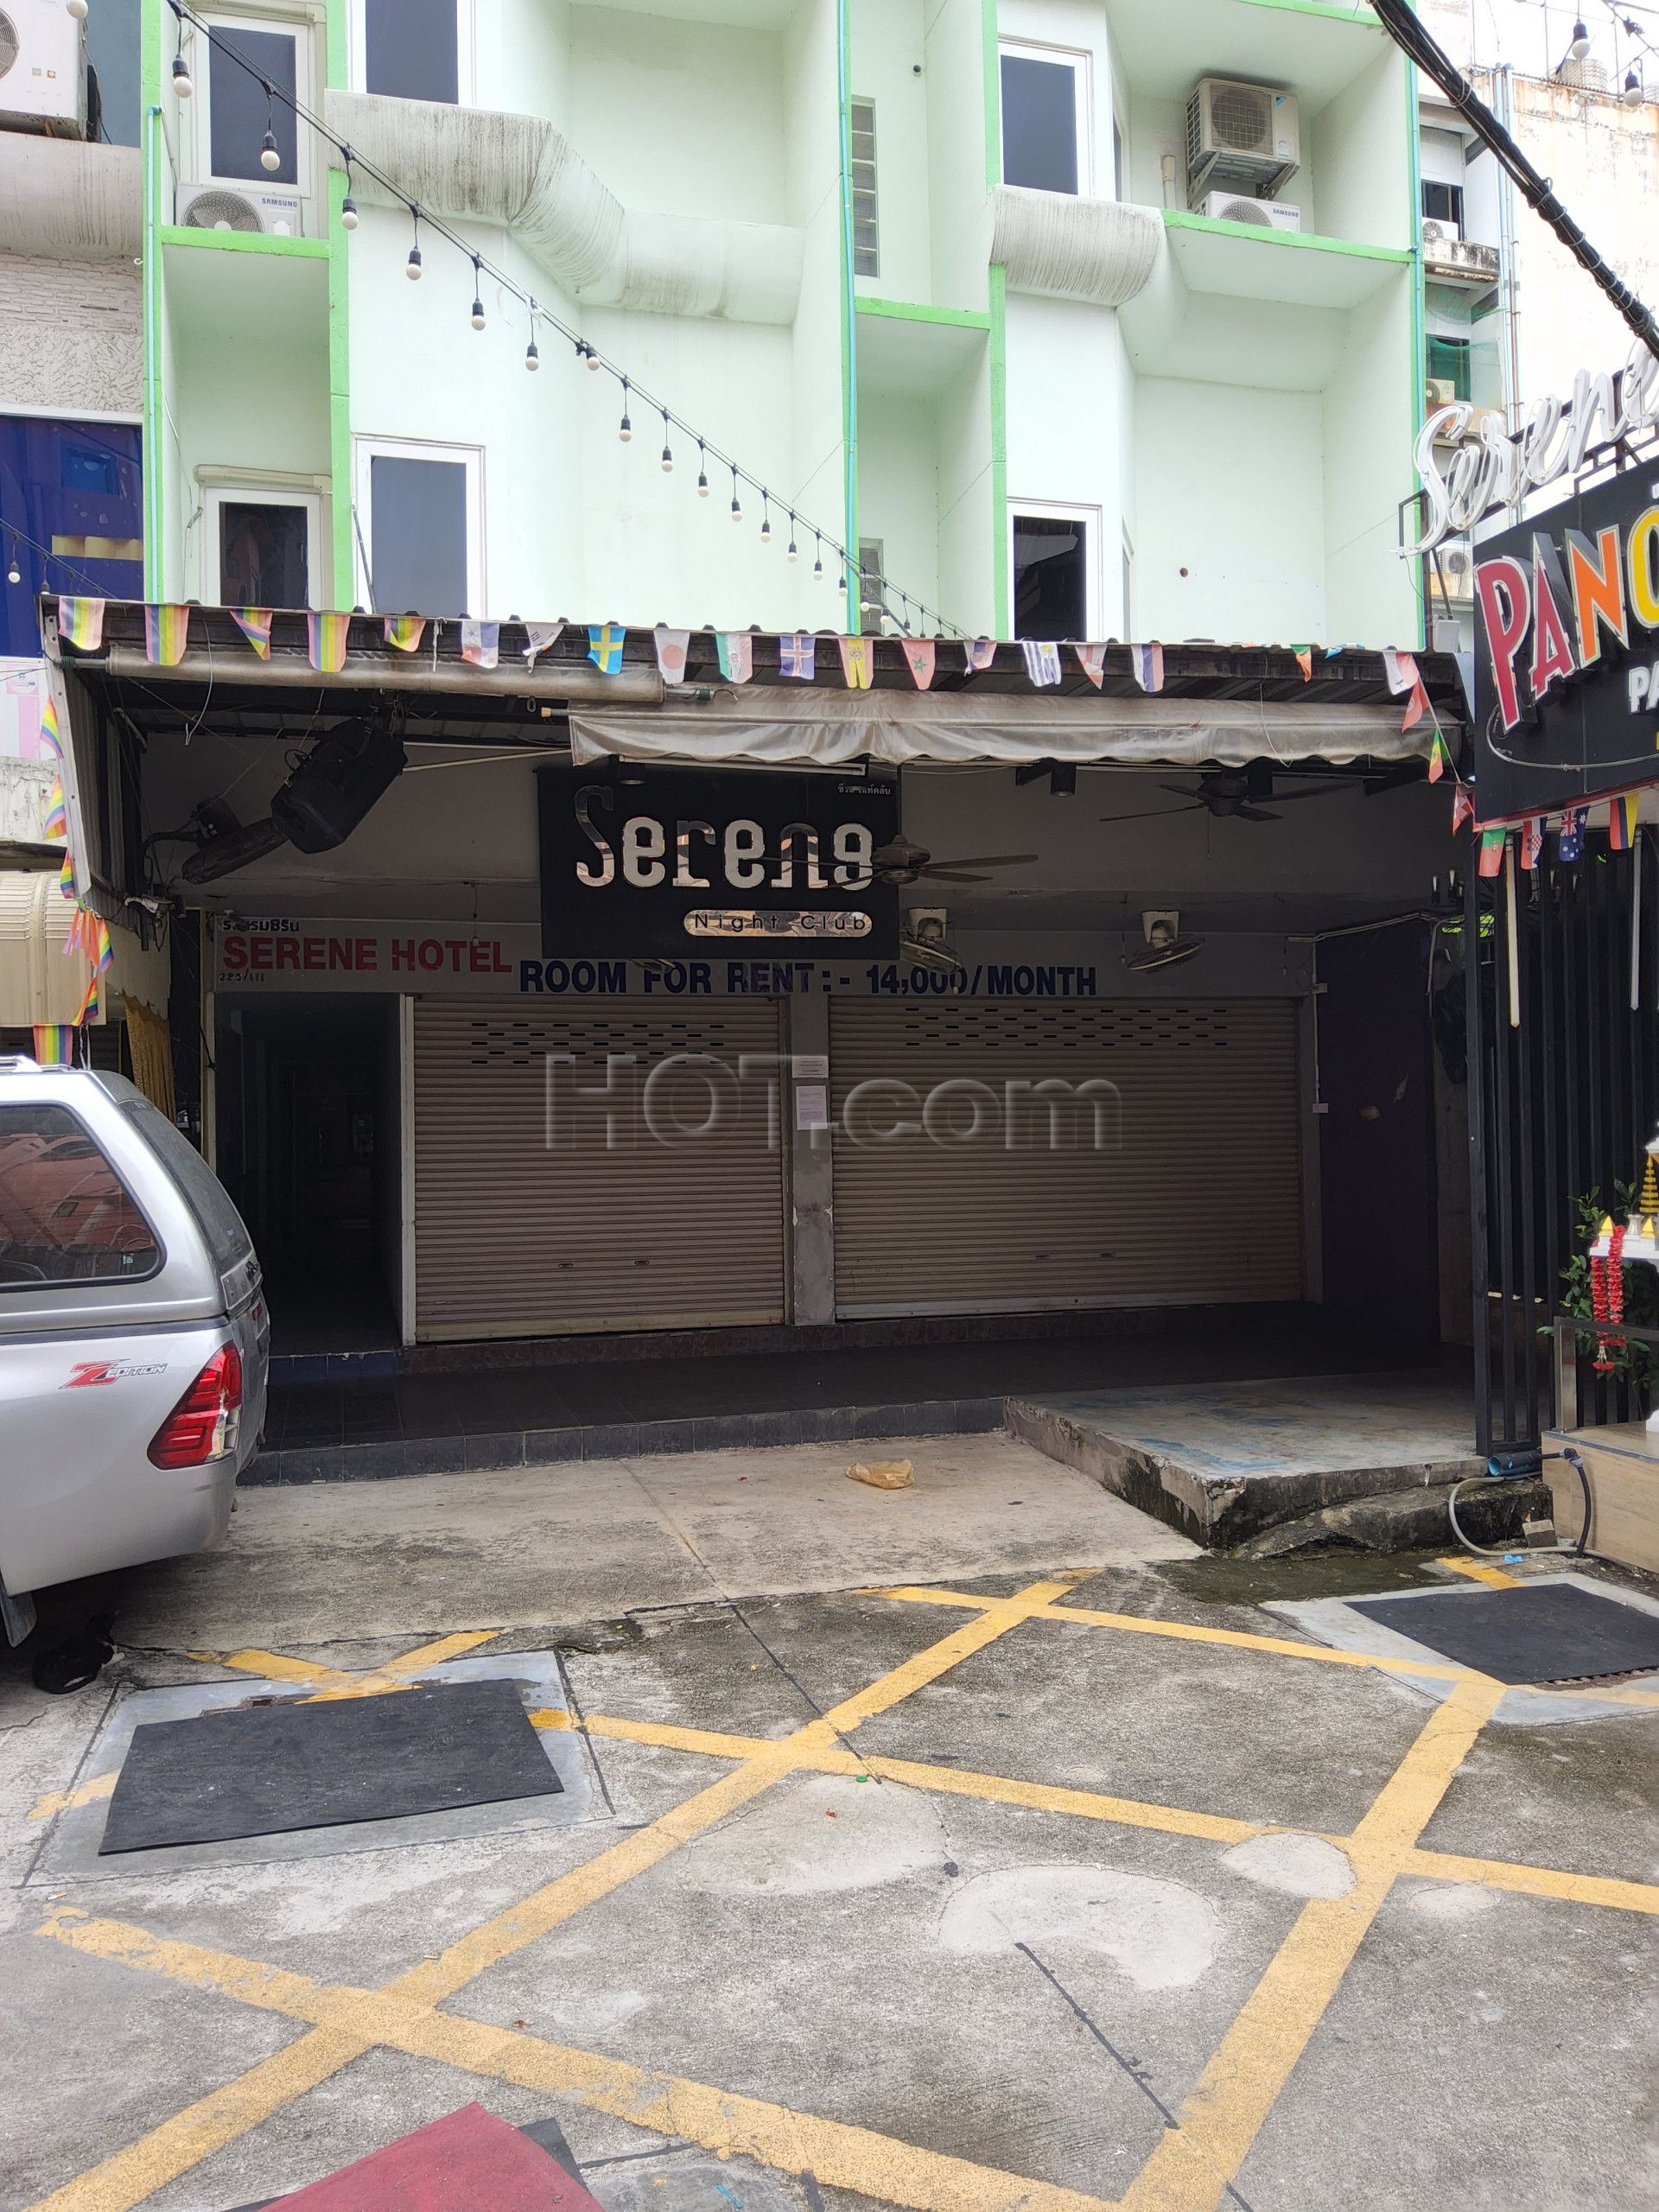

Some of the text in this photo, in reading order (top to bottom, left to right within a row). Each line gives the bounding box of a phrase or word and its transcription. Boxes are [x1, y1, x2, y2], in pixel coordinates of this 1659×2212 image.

[262, 198, 297, 207] SAMSUNG
[1272, 207, 1299, 218] SAMSUNG
[695, 913, 866, 932] Night Club
[223, 936, 512, 973] SERENE HOTEL
[520, 960, 626, 993] ROOM
[644, 961, 712, 994] FOR
[105, 1363, 168, 1378] EDITION
